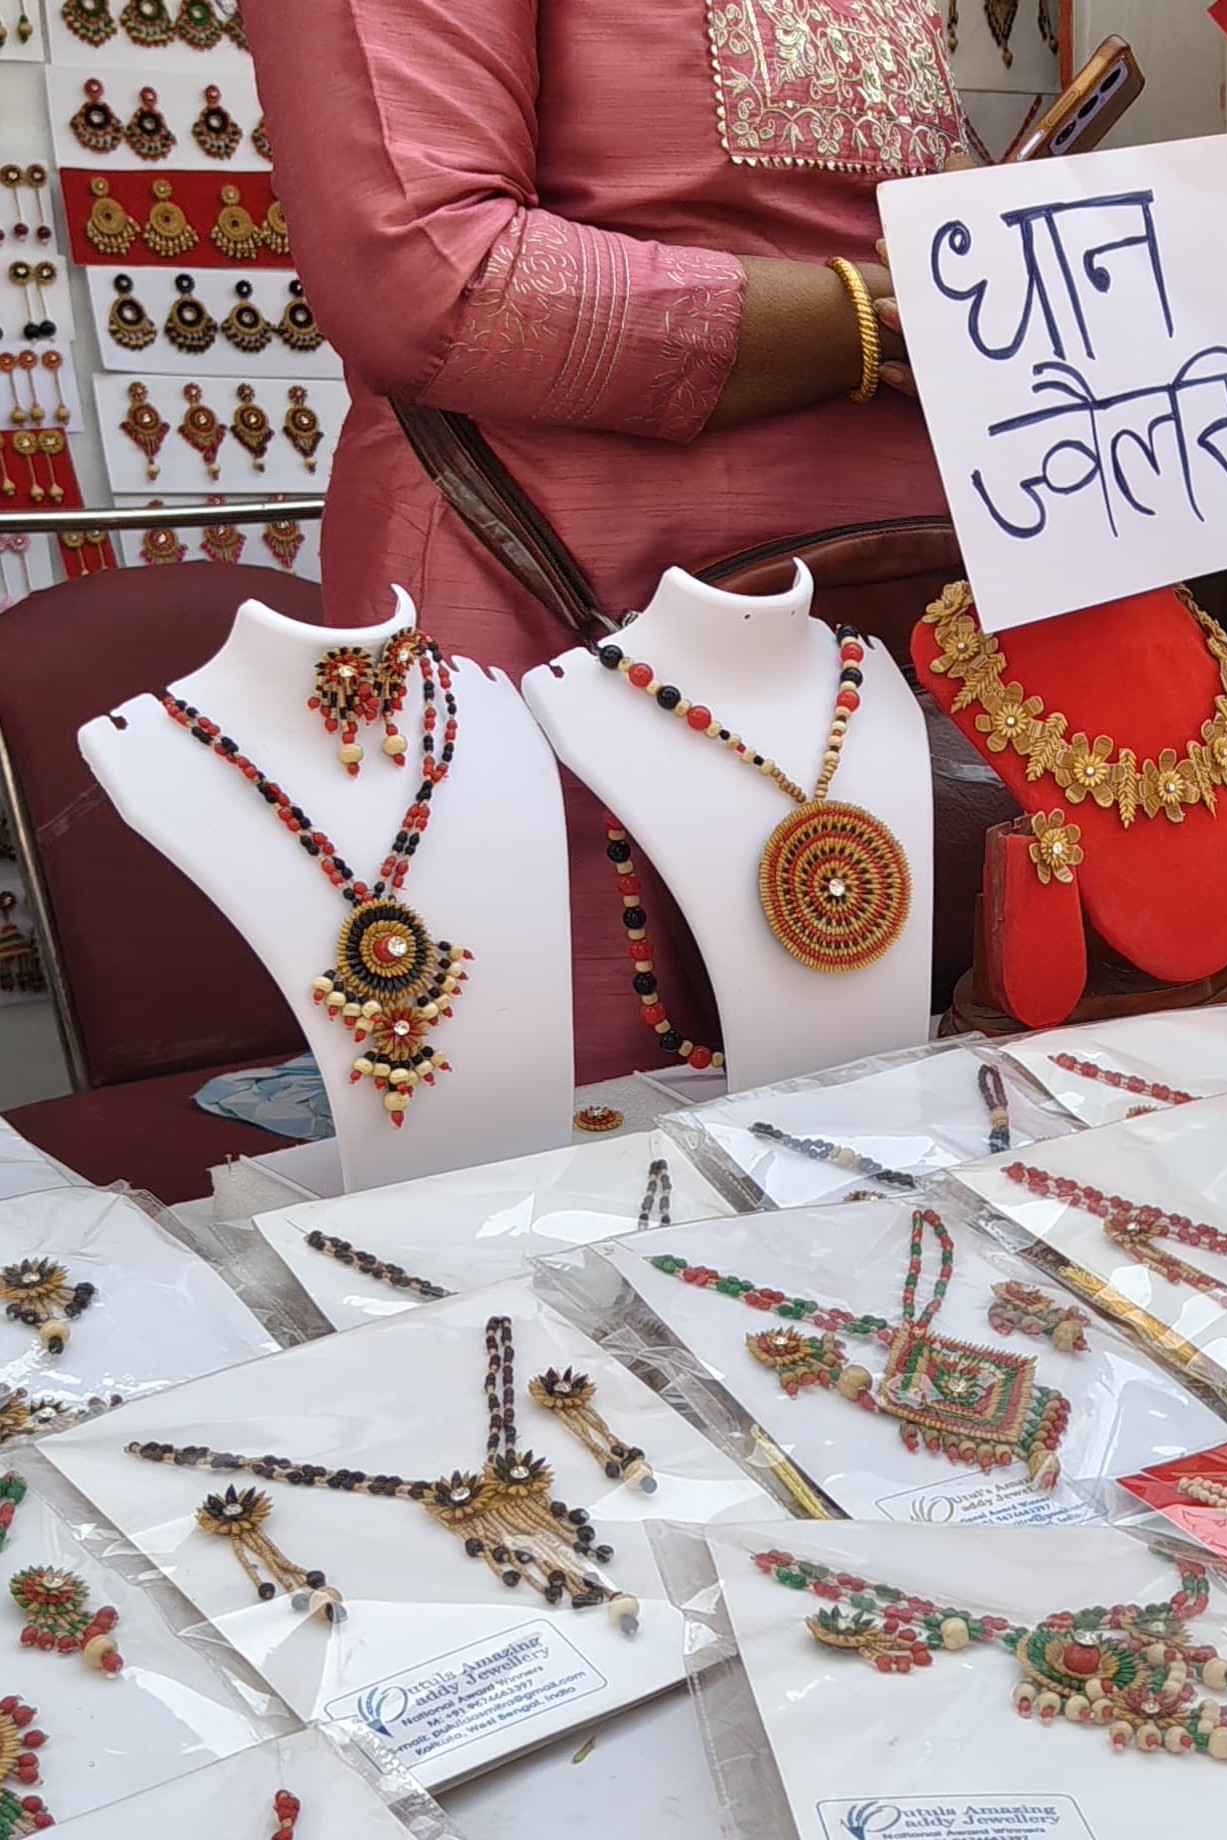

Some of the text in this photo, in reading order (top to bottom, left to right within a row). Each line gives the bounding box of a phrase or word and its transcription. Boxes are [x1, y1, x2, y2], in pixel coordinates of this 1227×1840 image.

[931, 189, 1175, 359] धान
[461, 1636, 543, 1675] Amazing
[465, 1646, 549, 1686] Jewellery
[401, 1699, 455, 1727] National
[457, 1683, 496, 1704] Award
[962, 1813, 1060, 1826] Jewellery
[963, 1804, 1058, 1816] Amazing
